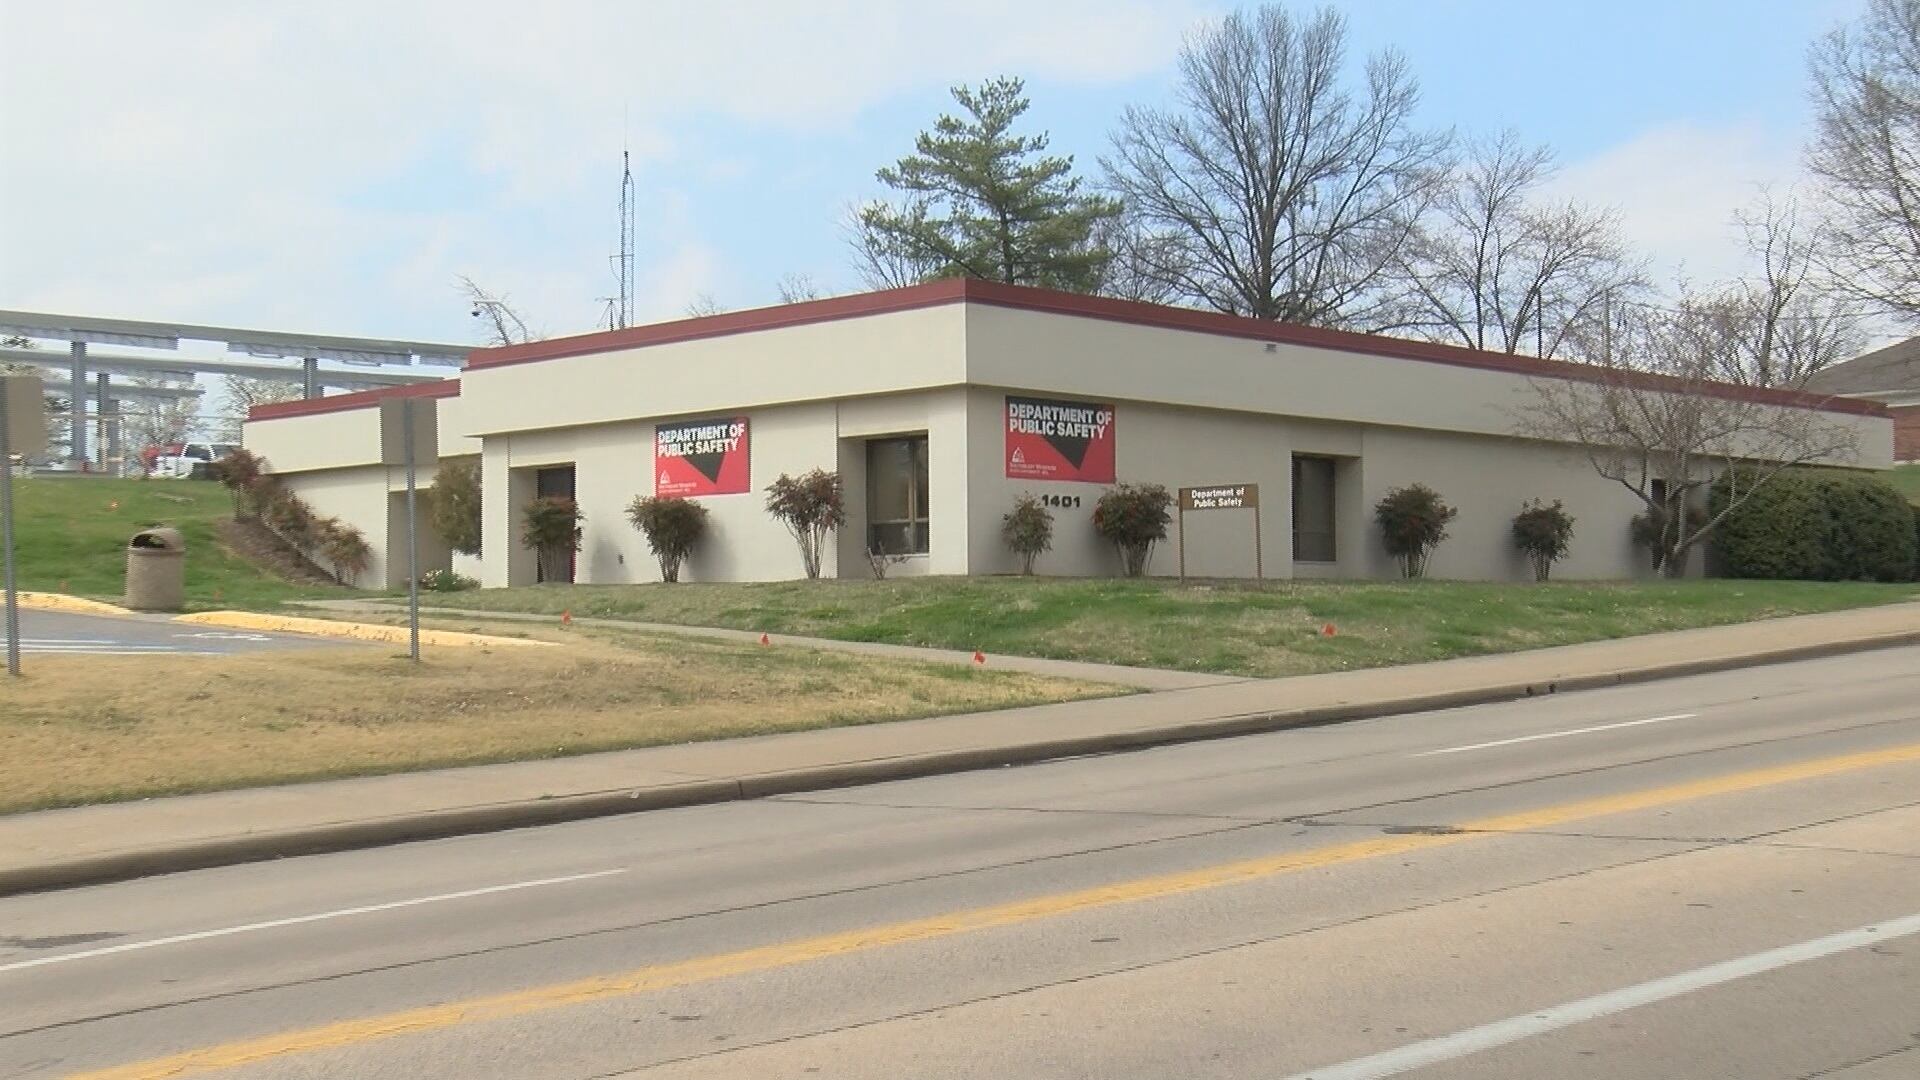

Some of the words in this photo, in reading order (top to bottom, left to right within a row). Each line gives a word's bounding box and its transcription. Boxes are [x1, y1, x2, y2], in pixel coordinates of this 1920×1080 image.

[1009, 403, 1094, 423] DEPARTMENT
[1096, 411, 1112, 425] OF
[658, 425, 728, 444] DEPARTMENT
[729, 423, 745, 437] OF
[1009, 418, 1055, 435] PUBLIC
[1057, 422, 1105, 439] SAFETY
[658, 442, 694, 458] PUBLIC
[695, 437, 739, 454] SAFETY
[1042, 495, 1080, 508] 1401
[1191, 488, 1234, 499] Department
[1236, 487, 1244, 495] of
[1194, 498, 1216, 508] Public
[1218, 497, 1243, 507] Safety
